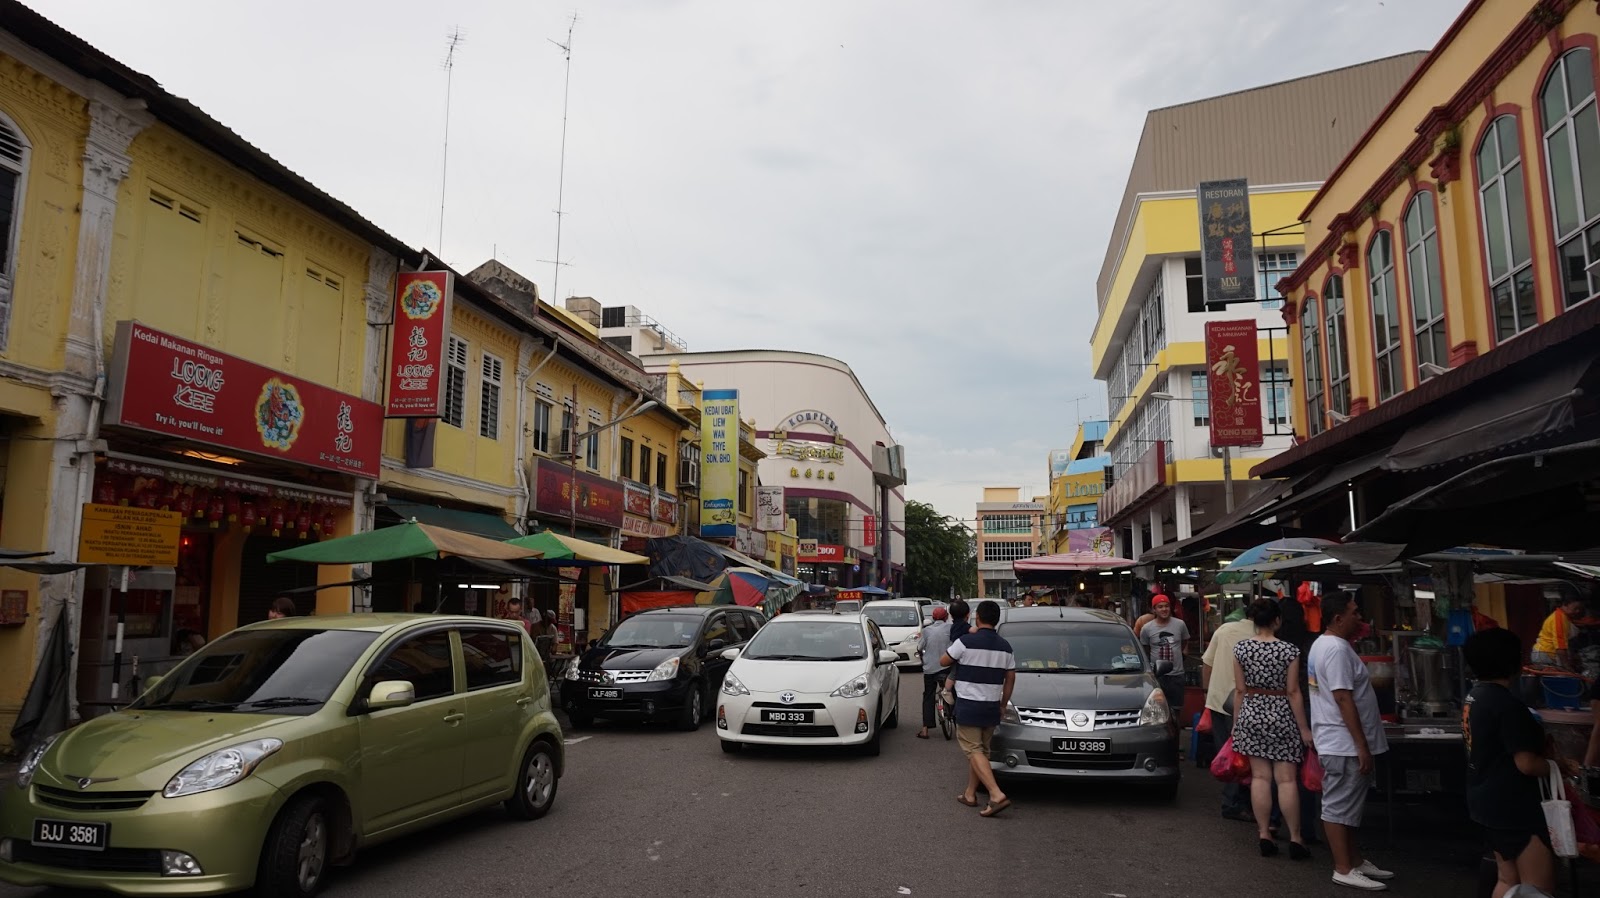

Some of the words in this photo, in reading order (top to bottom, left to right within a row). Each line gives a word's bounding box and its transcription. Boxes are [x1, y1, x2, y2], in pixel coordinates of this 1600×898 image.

[1205, 189, 1244, 199] RESTORAN
[1221, 277, 1240, 287] MXL
[134, 328, 158, 344] Kedai
[160, 337, 196, 356] Makanan
[197, 349, 223, 365] Ringan
[171, 357, 225, 392] LOONG
[397, 364, 434, 378] LOONG
[173, 384, 215, 413] KEE
[705, 406, 720, 415] KEDAI
[721, 405, 735, 415] UBAT
[156, 413, 168, 424] Try
[179, 420, 198, 430] you'll
[199, 423, 214, 434] love
[215, 426, 224, 436] it!
[788, 412, 838, 432] KOMPLEKS
[713, 430, 726, 439] WAN
[1217, 429, 1240, 437] YONG
[712, 441, 726, 451] THYE
[94, 507, 123, 515] KAWASAN
[788, 712, 805, 721] 333
[1058, 741, 1077, 750] JLU
[1079, 741, 1106, 751] 9389
[41, 823, 64, 841] BJJ
[69, 825, 98, 844] 3581
